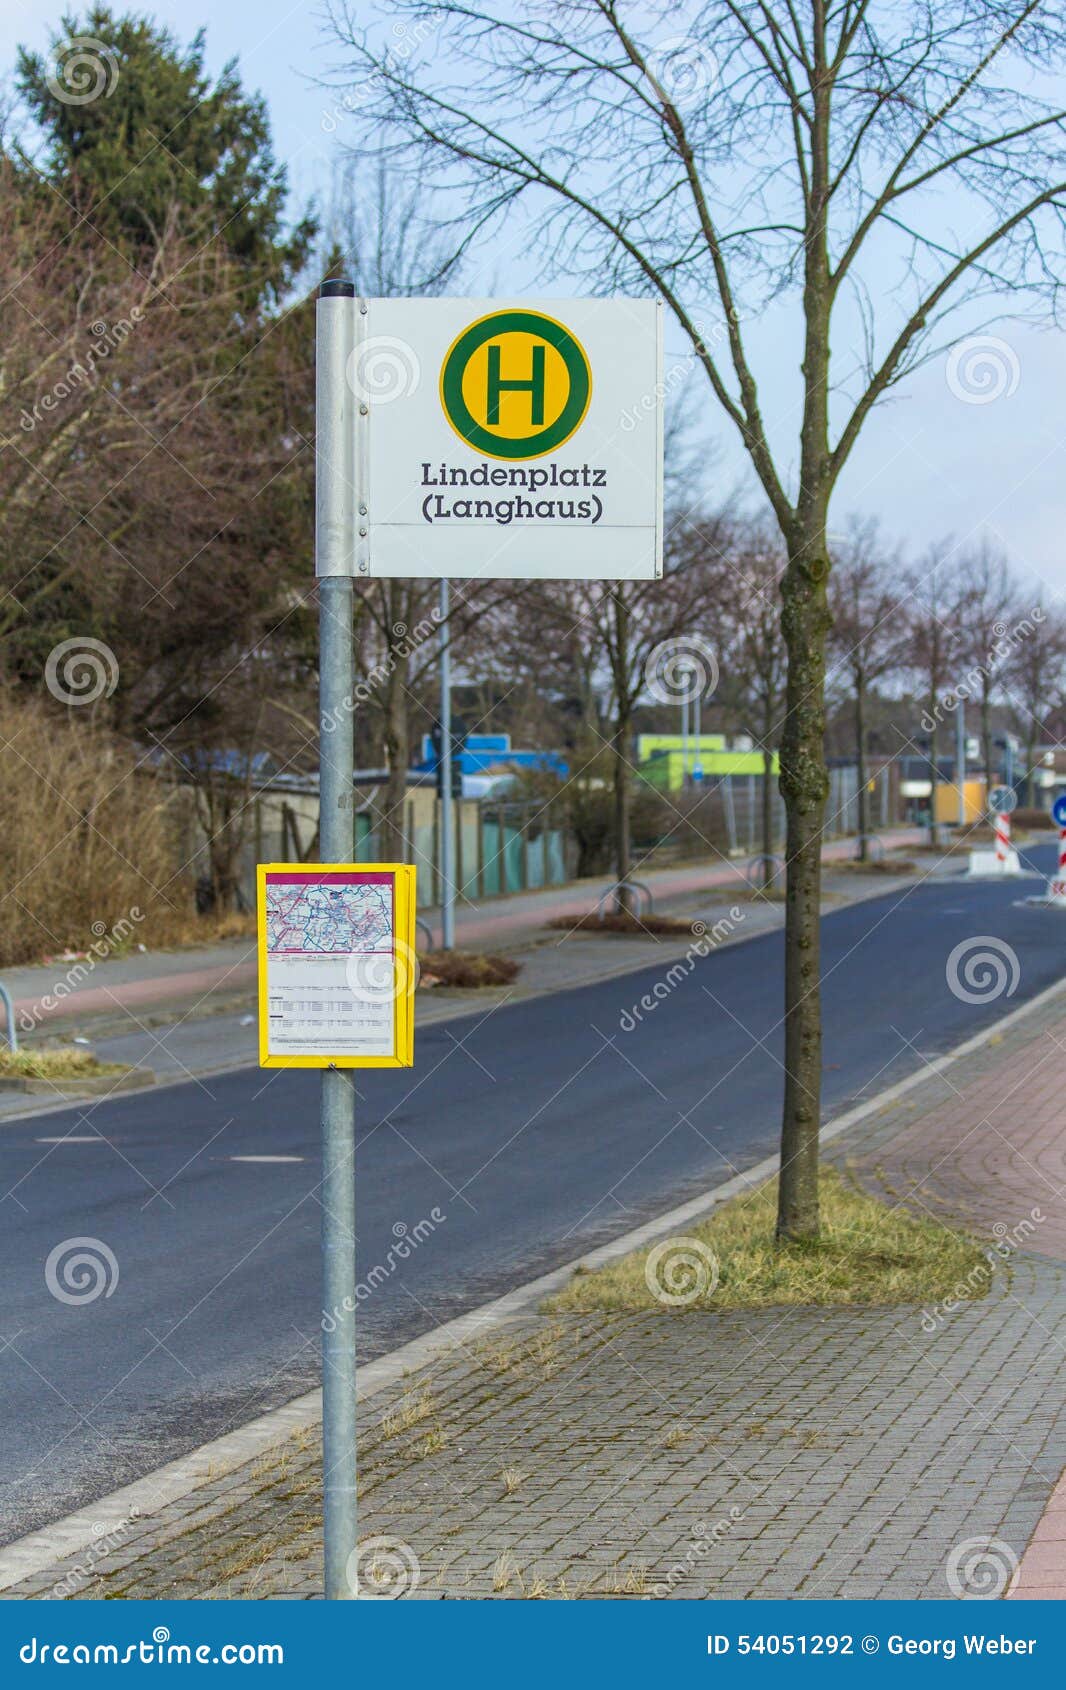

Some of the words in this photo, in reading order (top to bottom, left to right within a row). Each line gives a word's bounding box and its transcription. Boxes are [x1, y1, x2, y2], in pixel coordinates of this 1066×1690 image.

[486, 345, 546, 426] H
[421, 463, 607, 492] Lindenplatz
[422, 493, 603, 525] (Langhaus)
